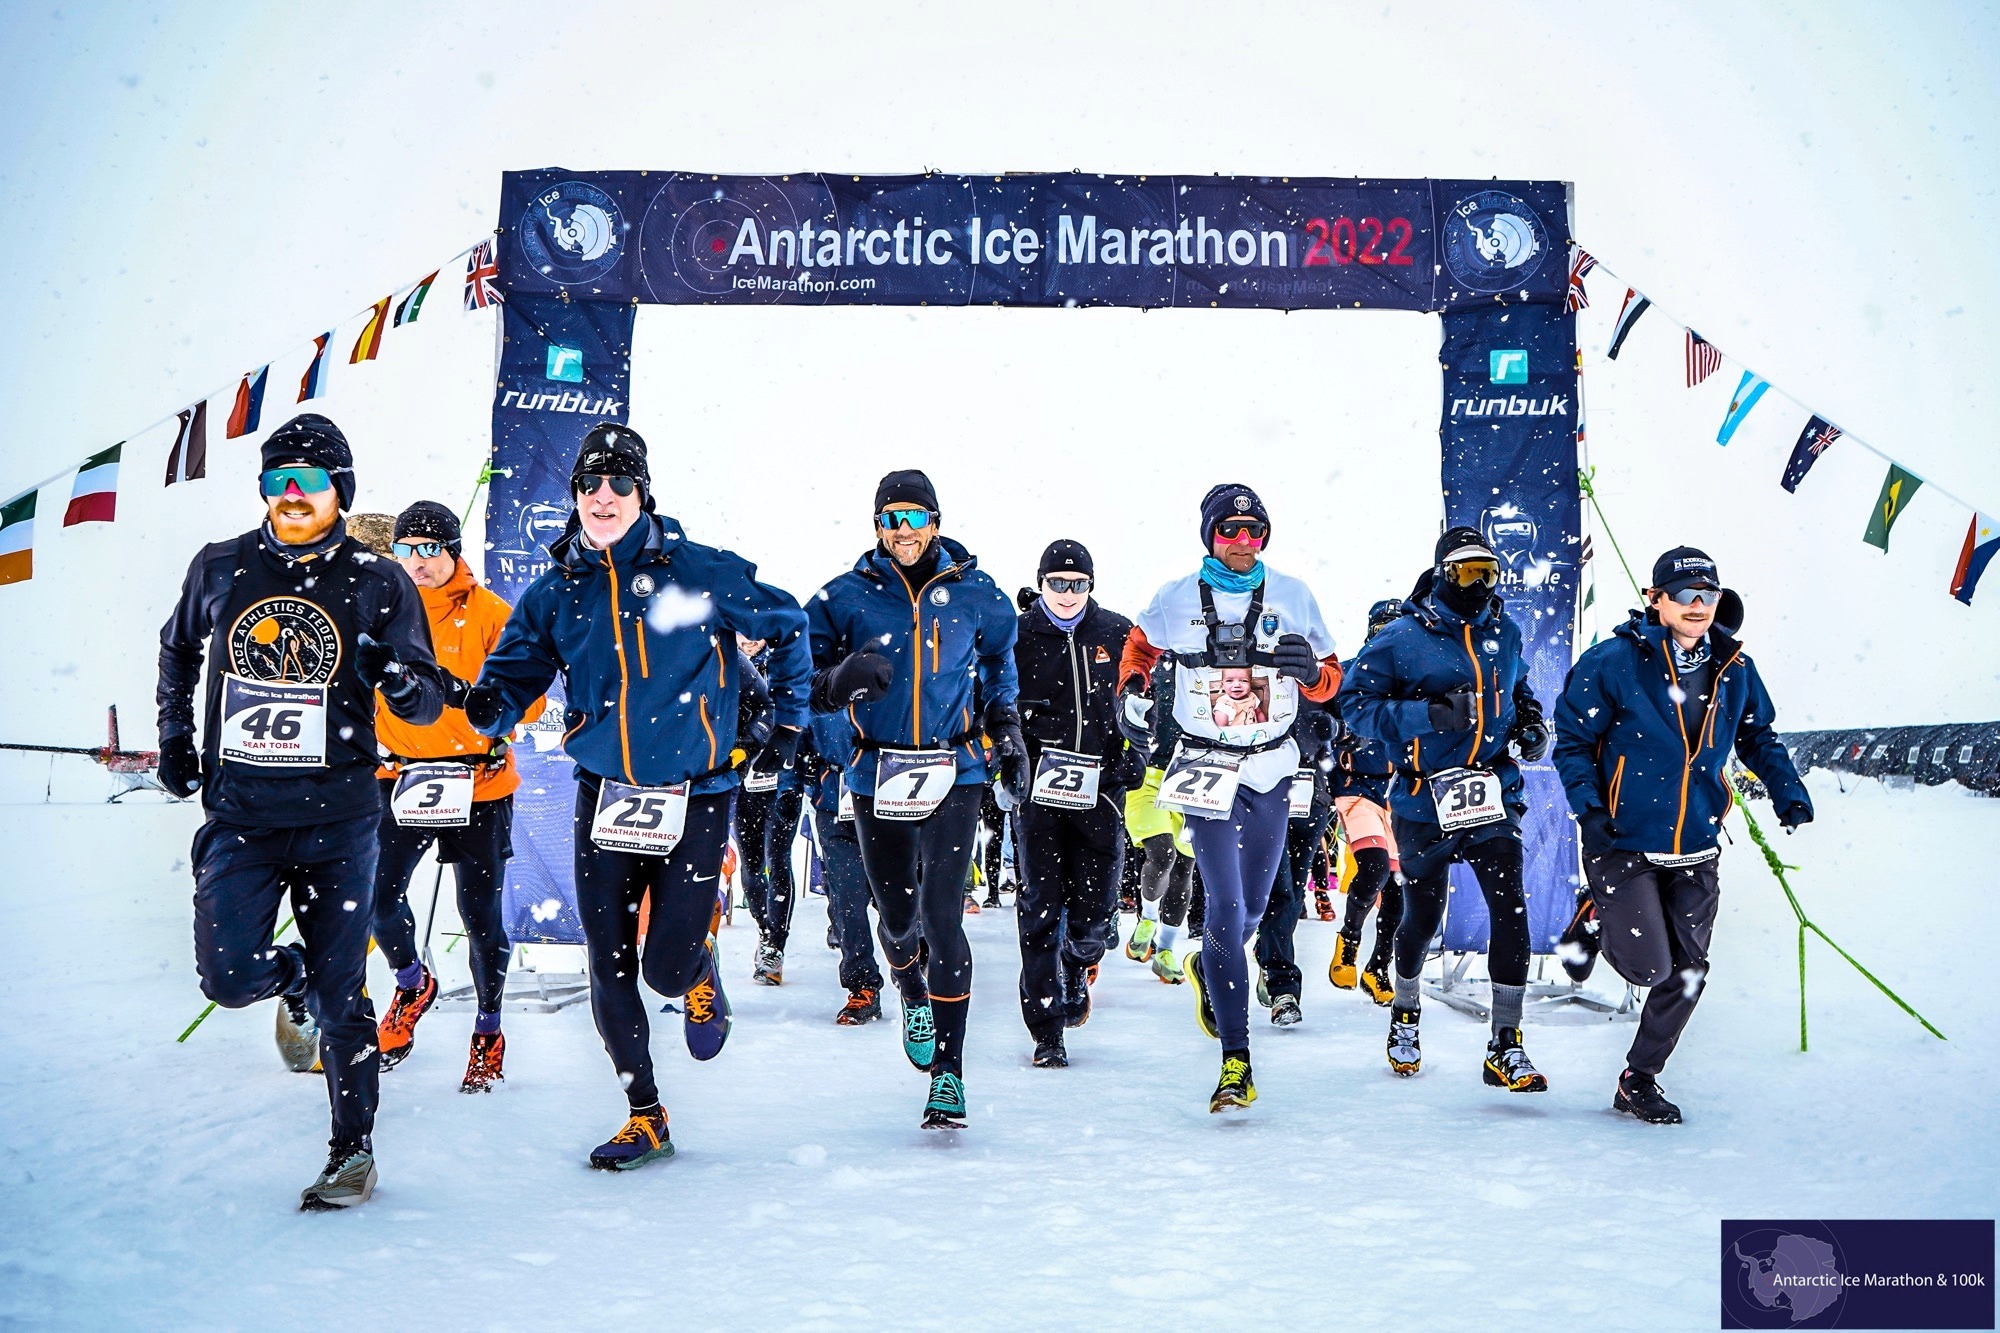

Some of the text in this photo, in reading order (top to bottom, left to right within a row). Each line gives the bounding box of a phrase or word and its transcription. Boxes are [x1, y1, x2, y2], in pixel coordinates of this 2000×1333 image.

[538, 191, 560, 207] Ice
[1456, 201, 1478, 218] Ice
[728, 215, 1414, 267] Antarctic Ice Marathon 2022
[732, 275, 876, 292] IceMarathon.com
[501, 390, 624, 416] runbuk
[1451, 395, 1569, 416] runbuk
[237, 602, 306, 638] ATHLETICS
[308, 612, 336, 685] FEDERATION
[238, 687, 270, 697] Antarctic
[284, 693, 320, 701] Marathon
[241, 707, 303, 741] 46
[242, 740, 266, 749] SEAN
[226, 750, 319, 762] WWW.ICEMARATHON.COM
[907, 772, 929, 799] 7
[1048, 767, 1084, 792] 23
[1175, 768, 1223, 795] 27
[418, 783, 444, 808] 3
[1062, 791, 1091, 800] GREALISH
[1168, 793, 1189, 801] ALAIN
[1451, 780, 1486, 812] 38
[613, 797, 666, 830] 25
[1446, 805, 1496, 819] DEAN ROTENBERG
[597, 826, 678, 841] JONATHAN HERRICK
